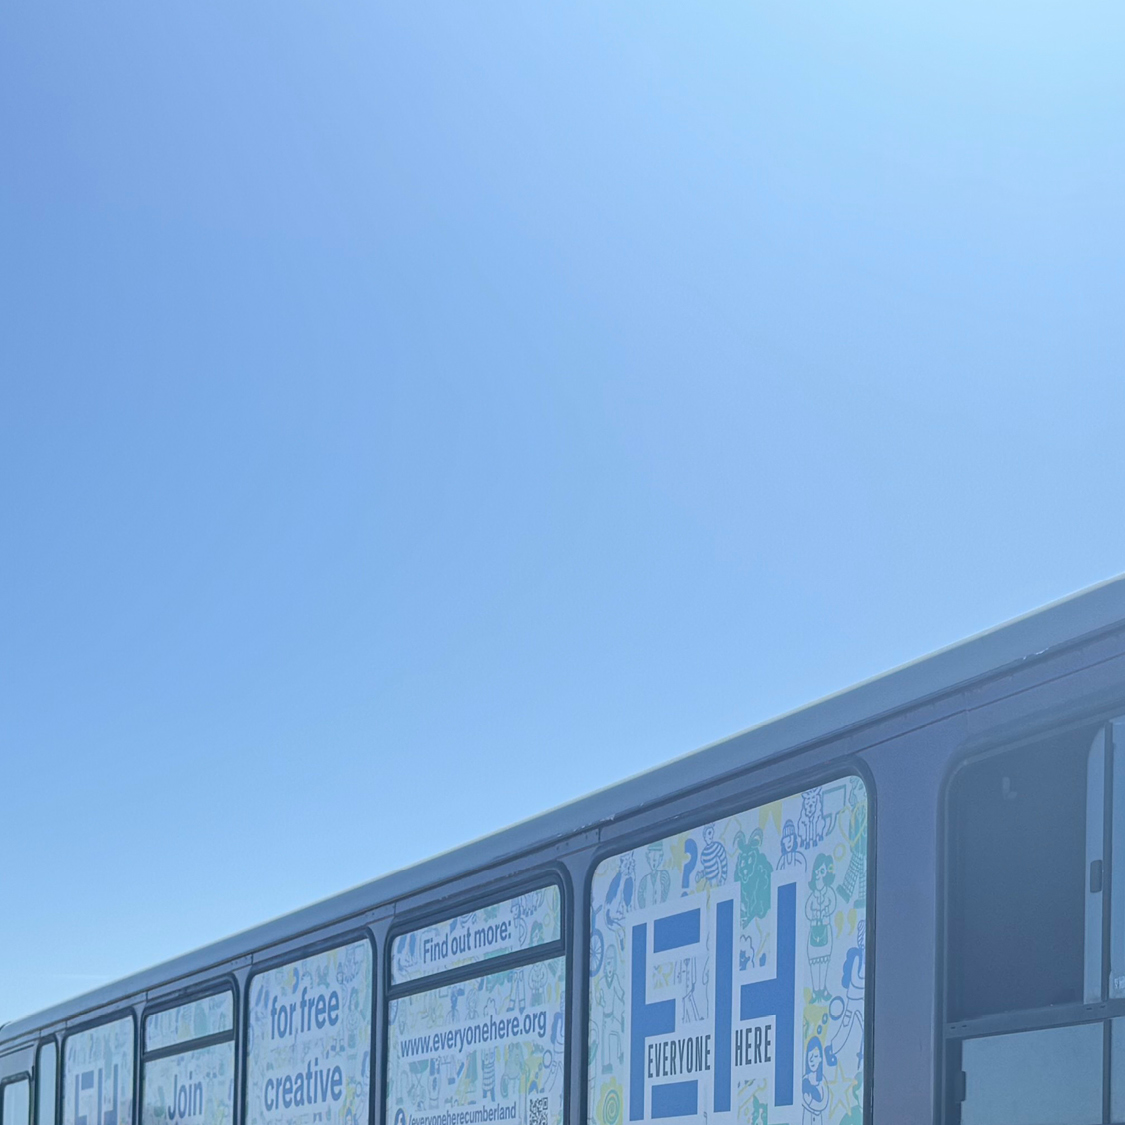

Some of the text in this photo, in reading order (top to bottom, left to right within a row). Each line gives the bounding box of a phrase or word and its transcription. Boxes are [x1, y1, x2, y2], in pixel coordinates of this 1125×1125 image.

[423, 921, 512, 963] Find out more:
[271, 988, 340, 1040] for free
[400, 1010, 547, 1058] www.everyonehere.org
[647, 1024, 772, 1078] EVERYONE HERE
[168, 1070, 203, 1121] Join
[264, 1058, 343, 1112] creative
